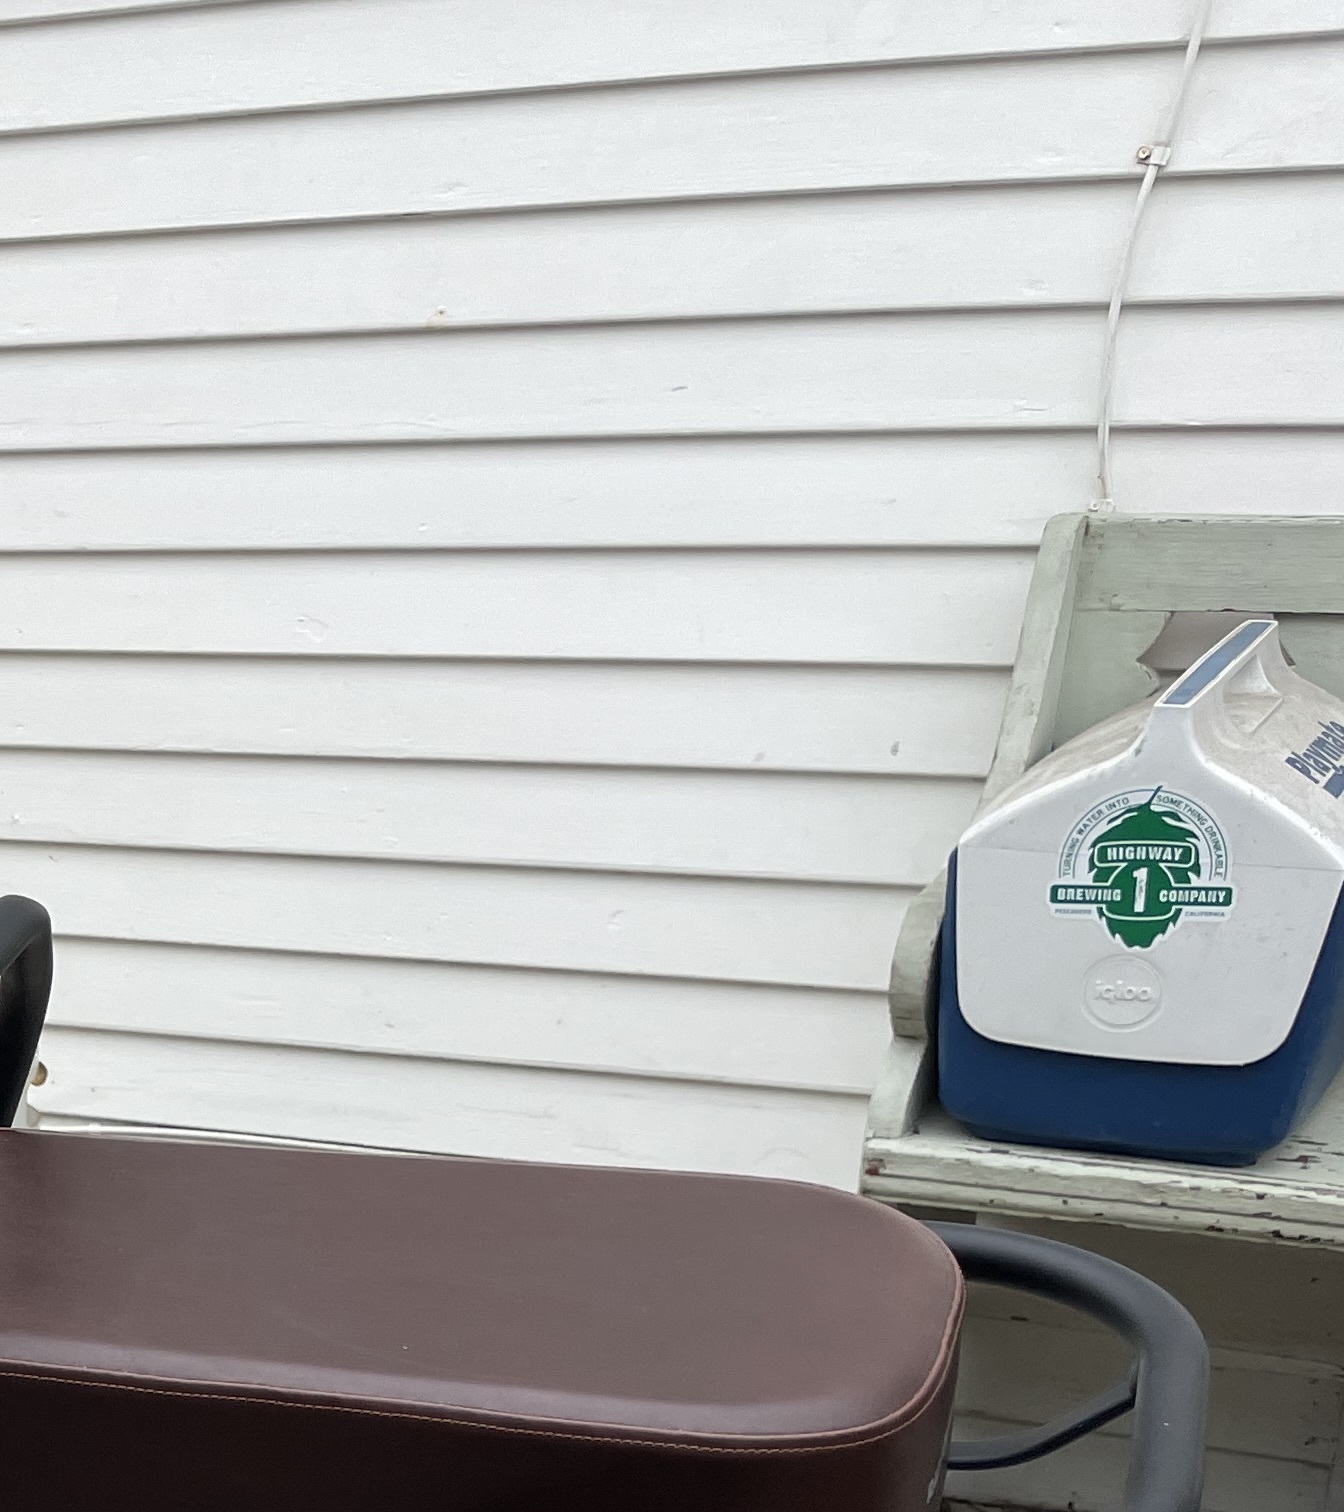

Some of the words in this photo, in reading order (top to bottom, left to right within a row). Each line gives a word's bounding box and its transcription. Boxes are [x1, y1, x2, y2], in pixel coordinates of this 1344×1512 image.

[1062, 837, 1081, 877] TURNING
[1077, 808, 1105, 838] WATER
[1105, 796, 1131, 813] INTO
[1155, 794, 1209, 828] SOMETHING
[1204, 825, 1225, 878] DRINKABLE
[1106, 845, 1184, 862] HIGHWAY
[1056, 887, 1122, 902] BREWING
[1132, 866, 1149, 914] 1
[1159, 889, 1226, 904] COMPANY
